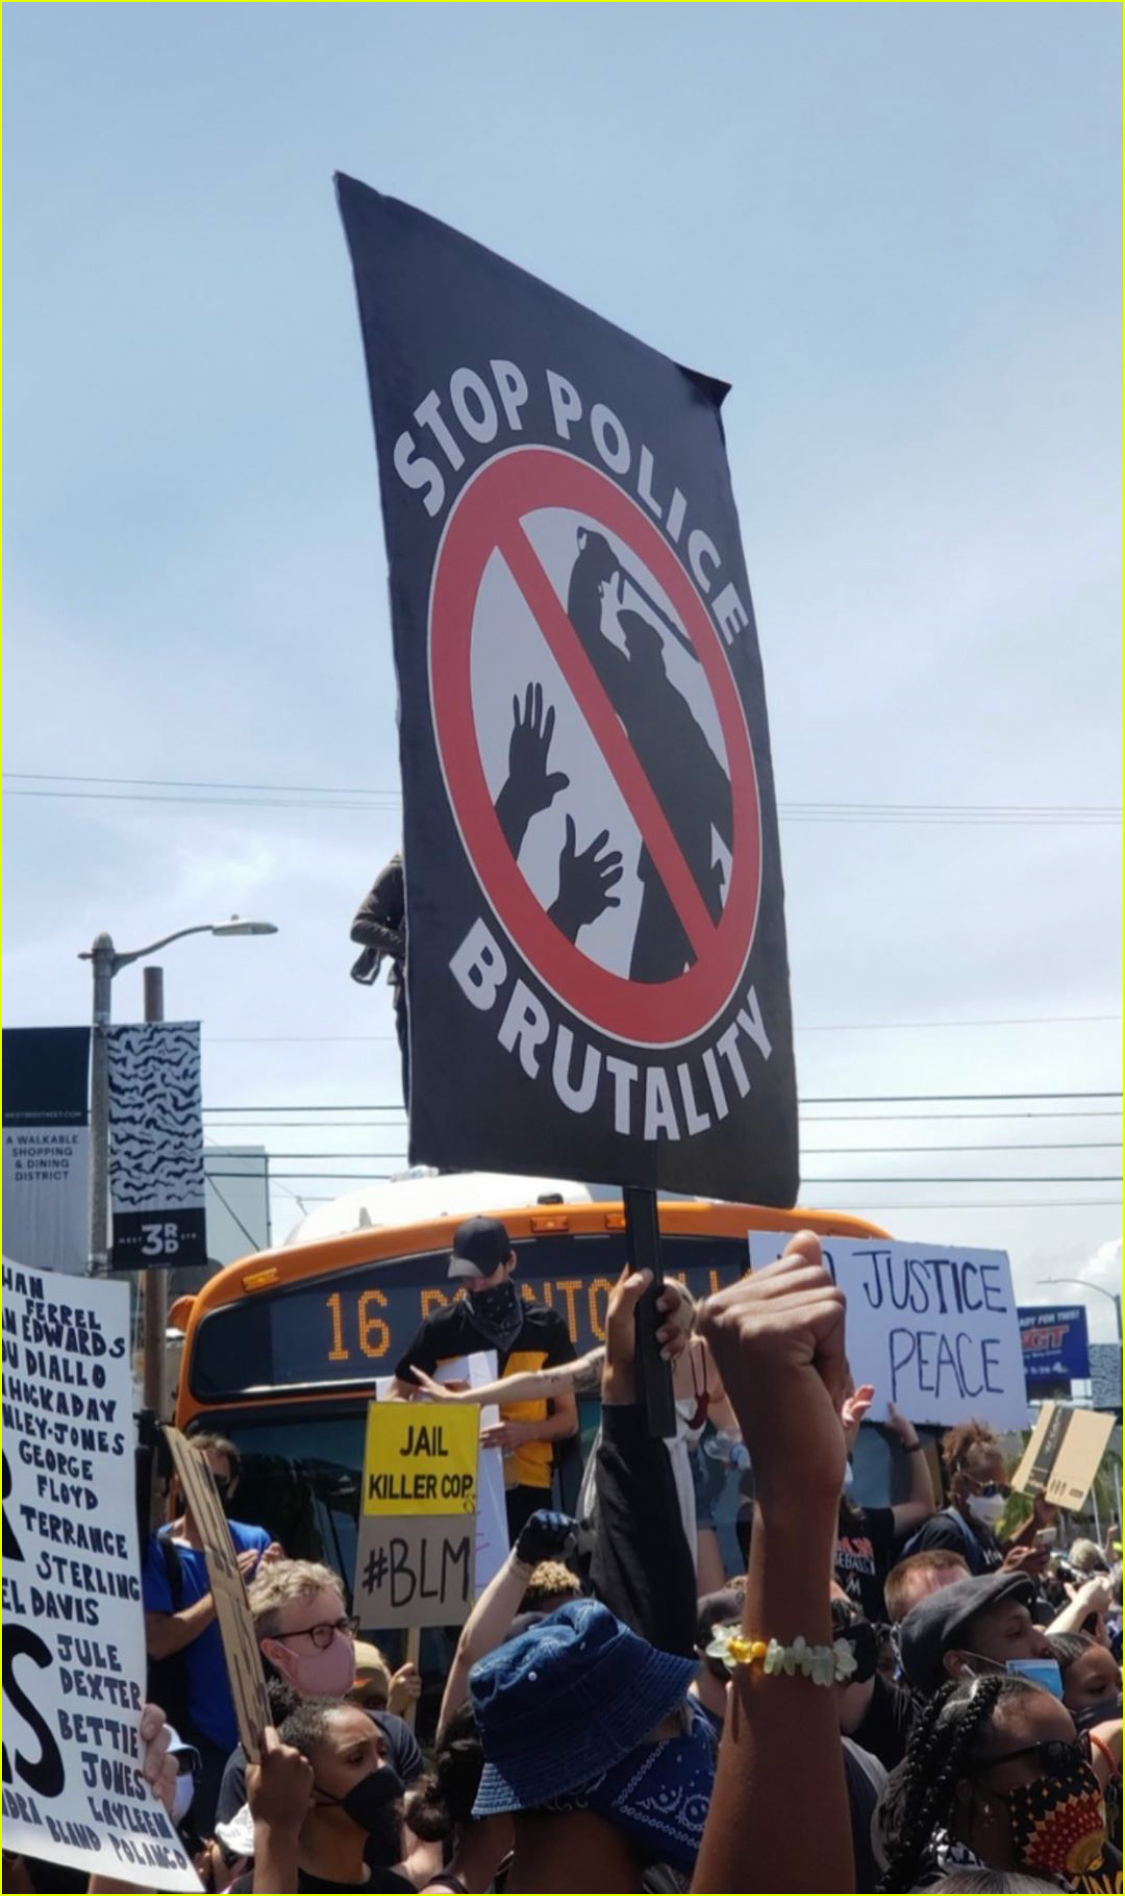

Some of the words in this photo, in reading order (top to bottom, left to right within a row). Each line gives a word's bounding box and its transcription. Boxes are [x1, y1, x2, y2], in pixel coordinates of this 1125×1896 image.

[393, 360, 528, 518] STOP
[546, 368, 749, 645] POLICE
[448, 917, 772, 1141] BRUTALITY
[6, 1136, 13, 1145] A
[17, 1135, 79, 1145] WALKABLE
[12, 1147, 73, 1157] SHOPPING
[15, 1159, 22, 1169] &
[27, 1159, 69, 1168] DINING
[15, 1171, 69, 1181] DISTRICT
[852, 1250, 1007, 1314] JUSTICE
[26, 1298, 101, 1330] FERREL
[326, 1289, 390, 1361] 16
[22, 1314, 125, 1358] EDWARDS
[25, 1347, 106, 1389] DIALLO
[890, 1328, 1005, 1403] PEACE
[9, 1376, 116, 1422] HOCKADAY
[19, 1439, 93, 1481] GEORGE
[400, 1425, 448, 1457] JAIL
[37, 1474, 98, 1510] FLOYD
[369, 1474, 437, 1500] KILLER
[20, 1504, 128, 1560] TERRANCE
[36, 1550, 140, 1601] STERLING
[362, 1536, 471, 1608] #BLM
[30, 1586, 99, 1626] DAVIS
[57, 1634, 122, 1672] JULE
[59, 1667, 142, 1711] DEXTER
[57, 1709, 139, 1759] BETTIE
[81, 1751, 146, 1801] JONES
[45, 1815, 101, 1851] BLAND
[87, 1796, 173, 1839] LAYLEEN
[108, 1832, 188, 1870] POLANCO
